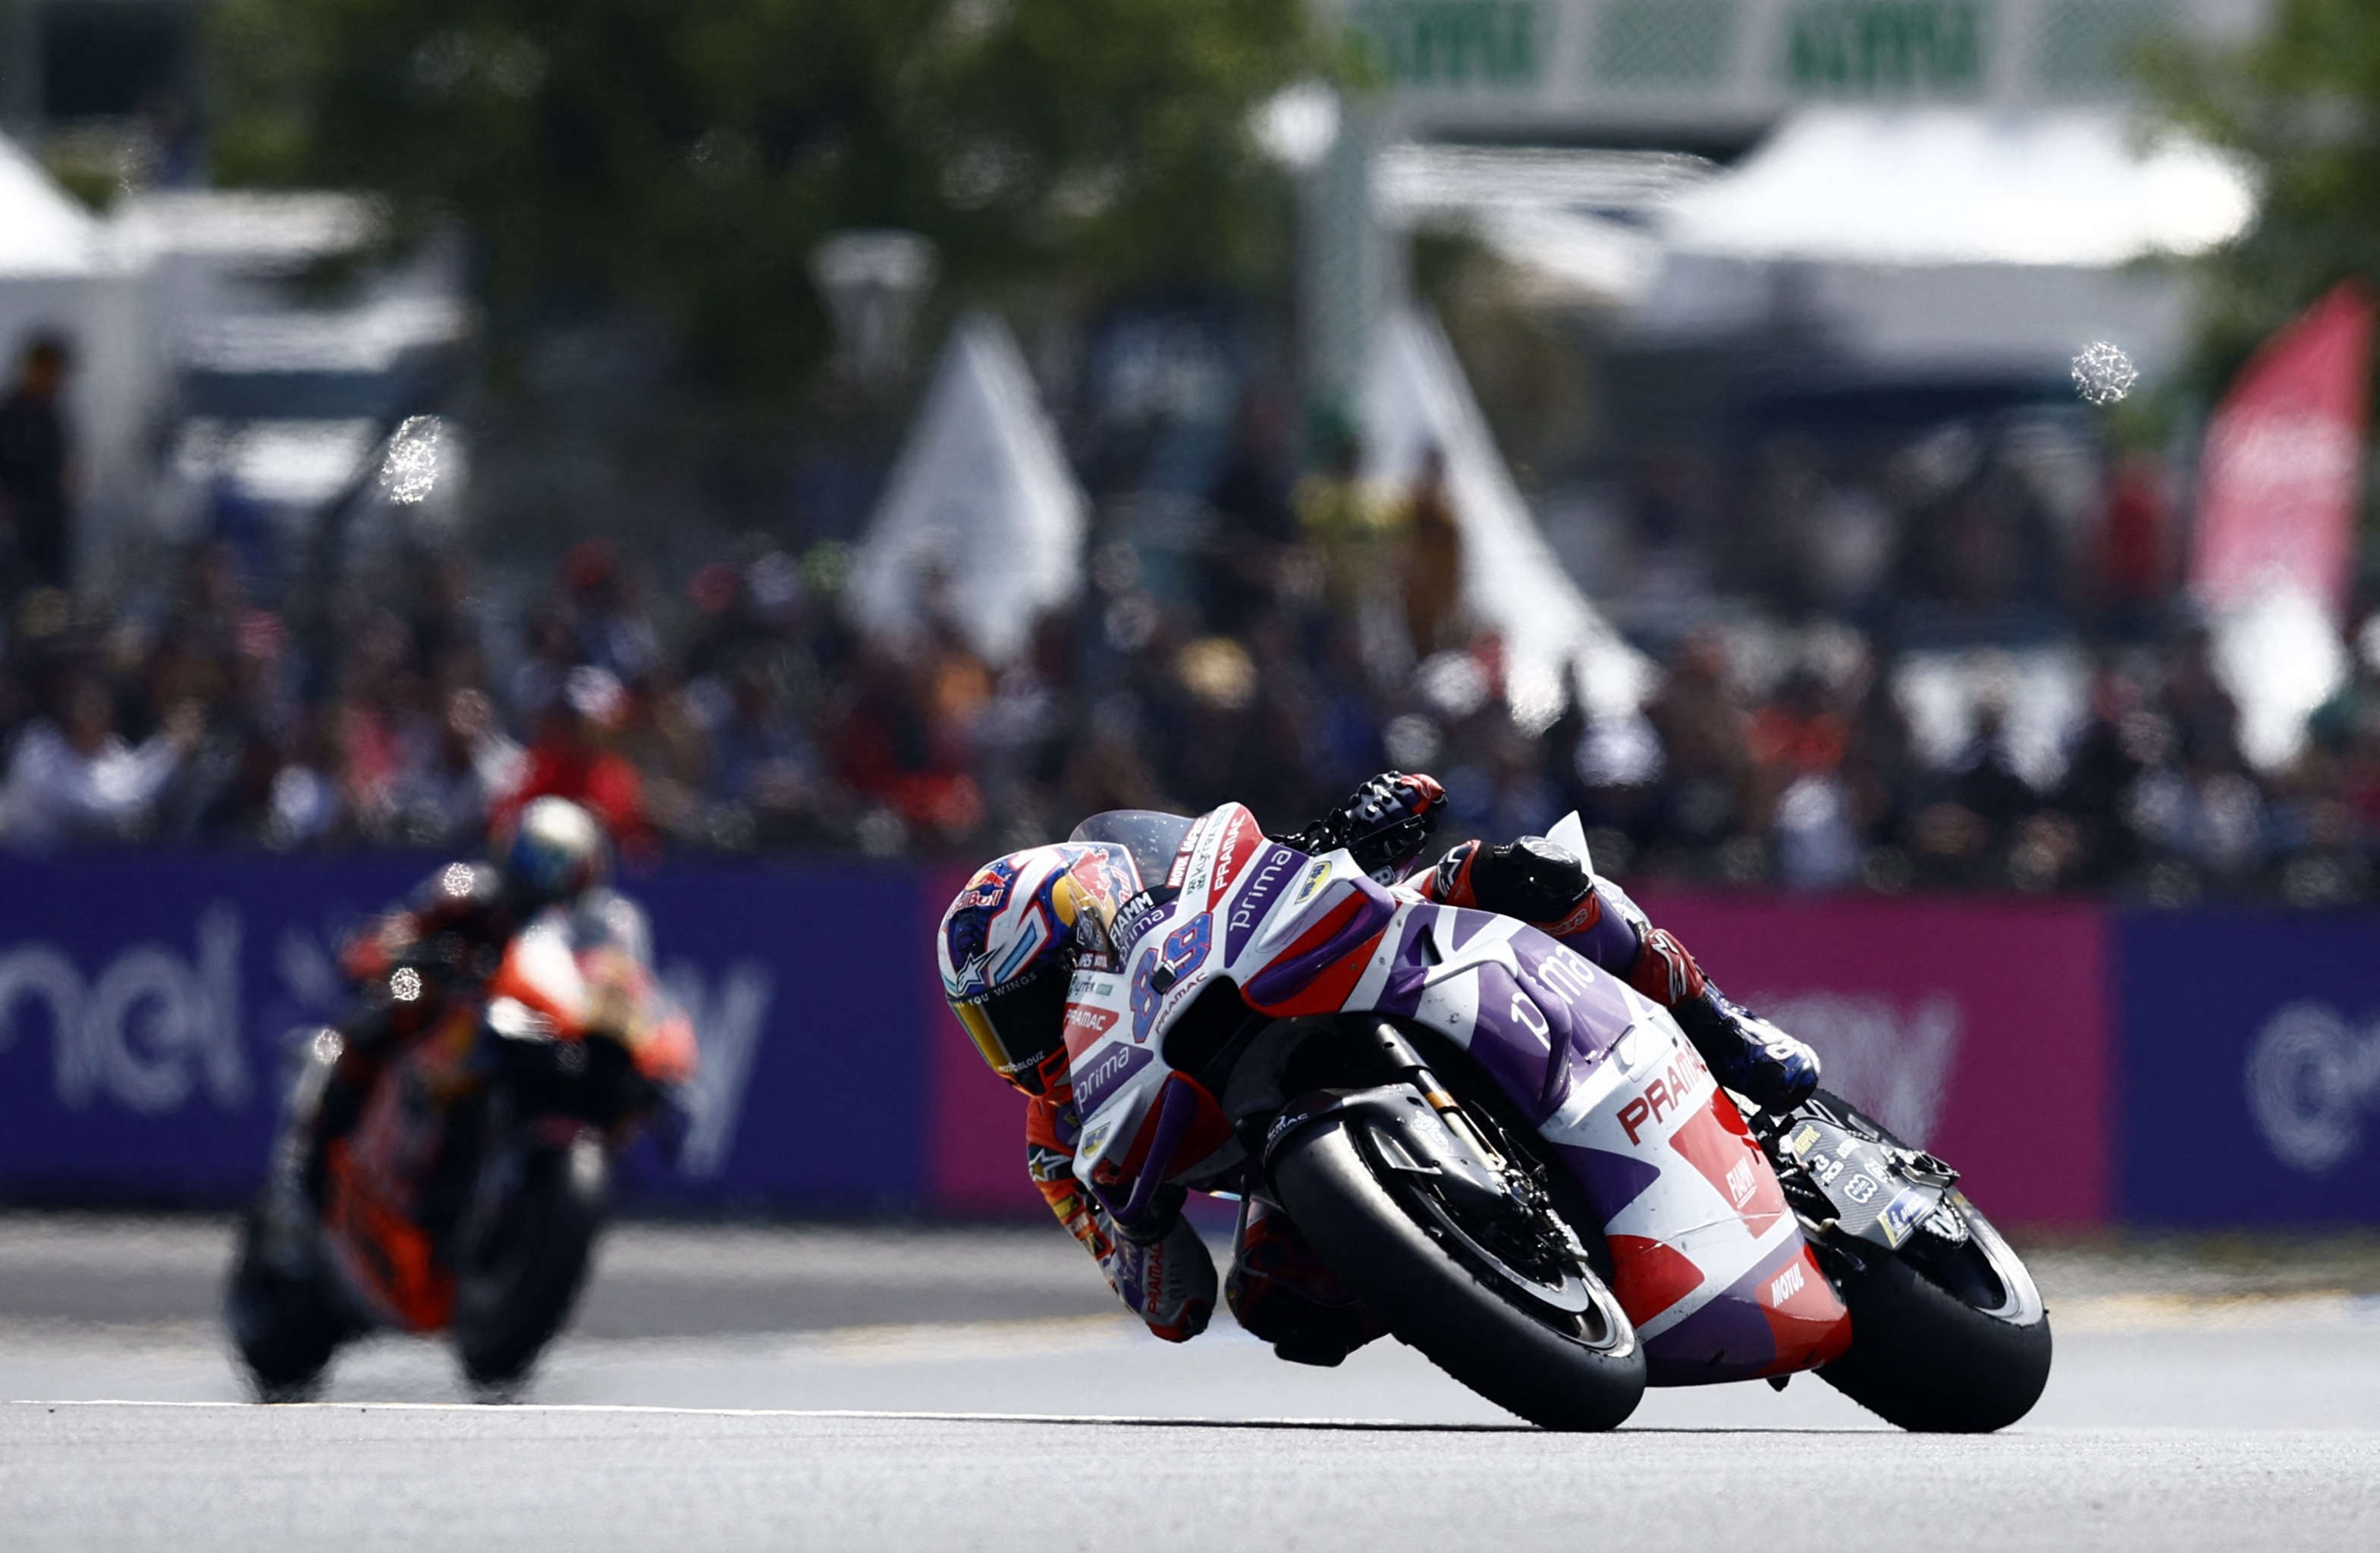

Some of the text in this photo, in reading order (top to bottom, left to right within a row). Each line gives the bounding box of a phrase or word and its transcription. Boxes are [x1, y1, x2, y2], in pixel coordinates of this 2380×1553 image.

[1167, 855, 1190, 886] MOTUL
[1214, 814, 1246, 891] PRAMAC
[1109, 891, 1154, 948] FIAMM
[1229, 849, 1292, 931] prima
[1119, 909, 1165, 965] prima
[967, 993, 990, 1006] YOU
[994, 972, 1037, 996] WINGS
[1129, 911, 1213, 1043] 89
[1155, 972, 1208, 1034] PRAMAC
[1073, 1046, 1129, 1113] prima
[1771, 1262, 1804, 1308] MOTUL
